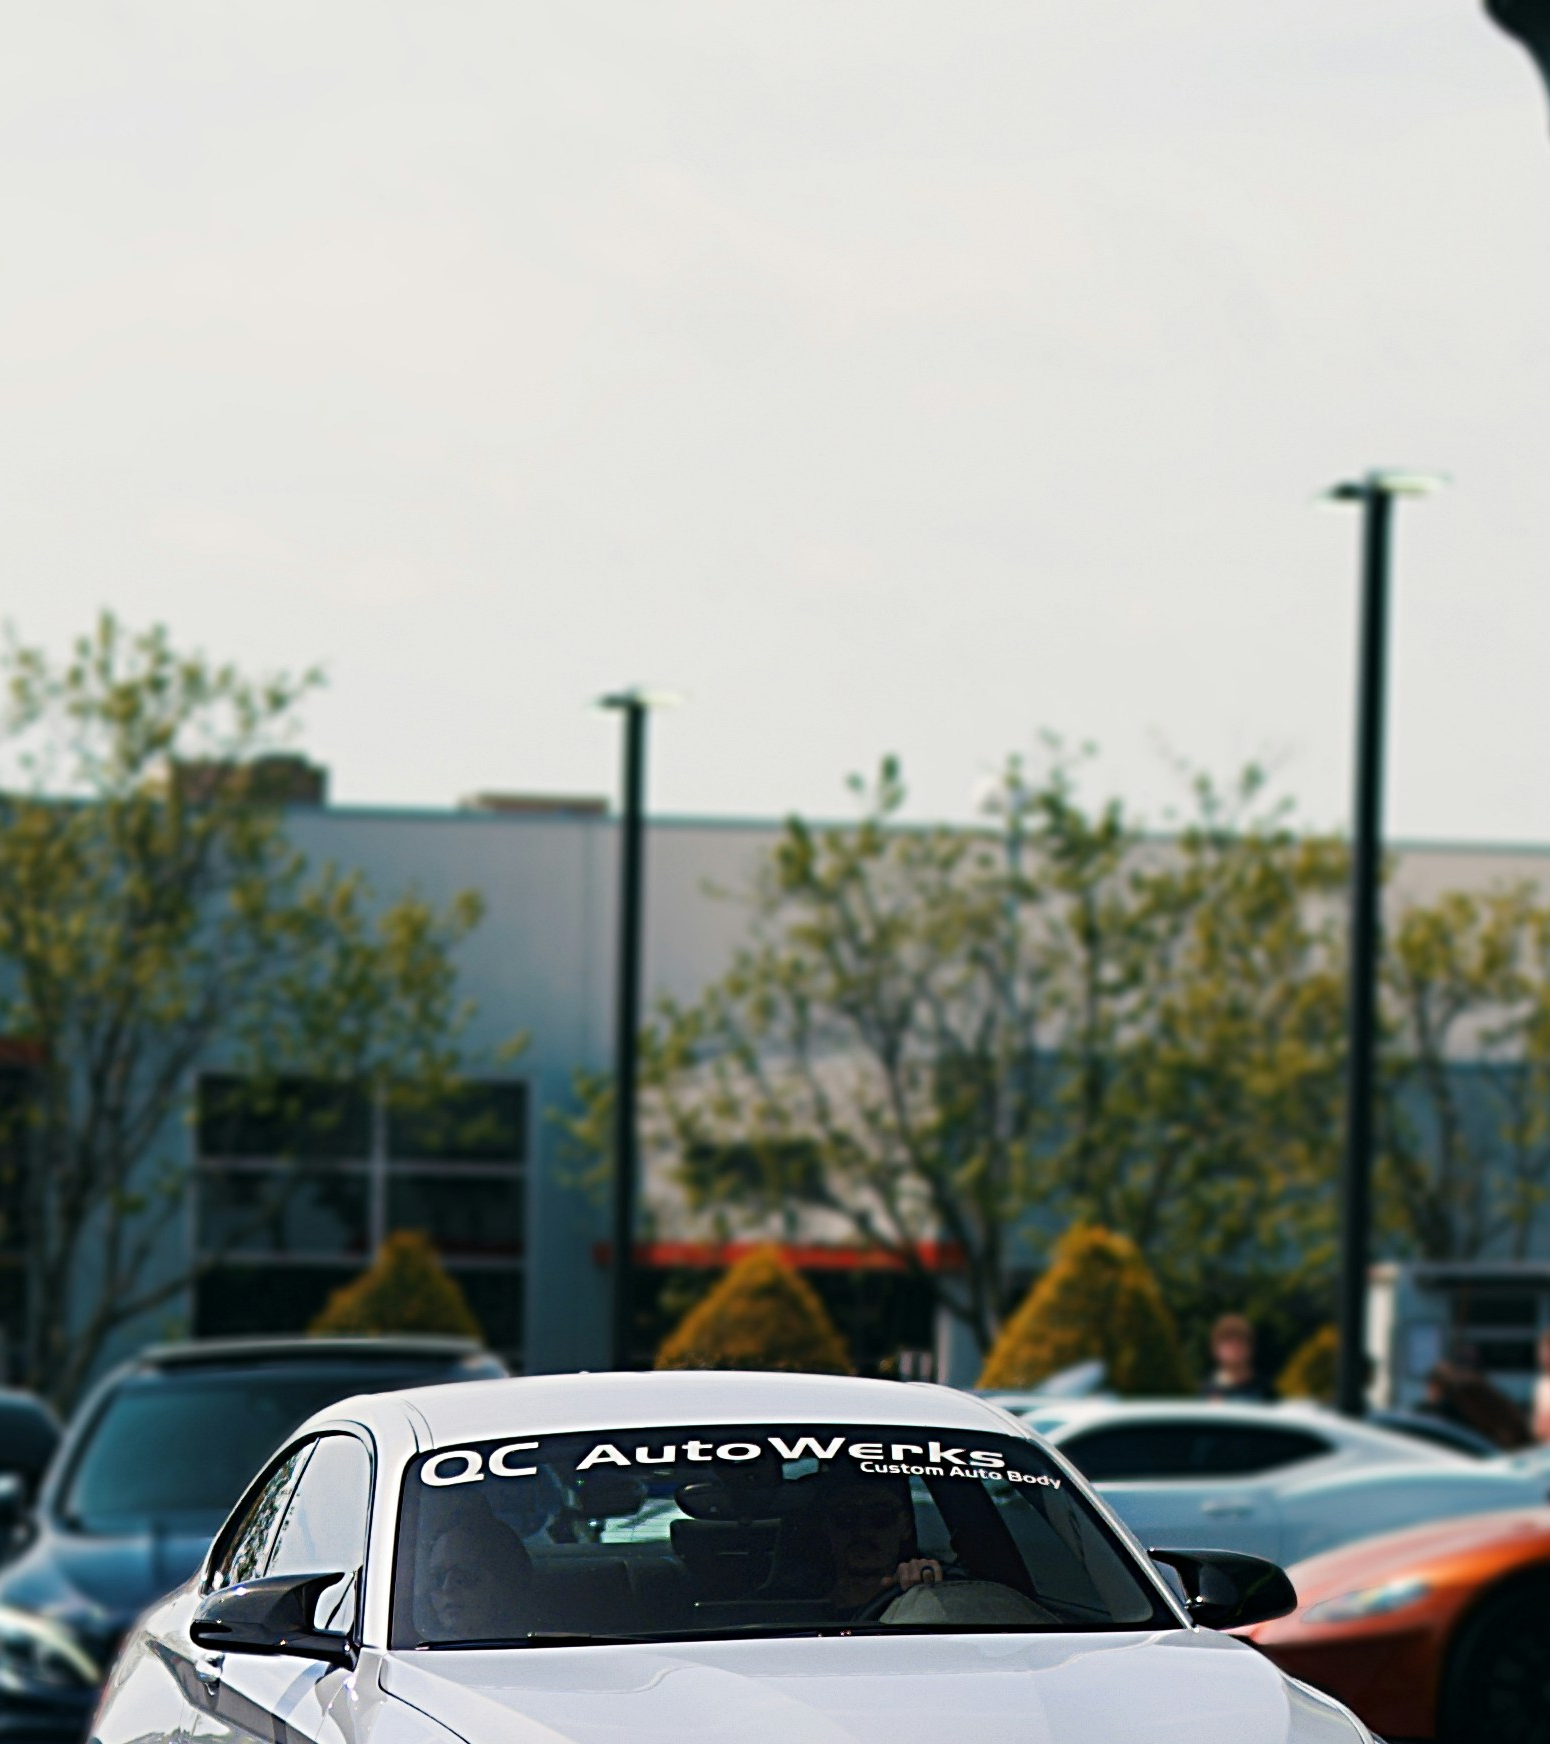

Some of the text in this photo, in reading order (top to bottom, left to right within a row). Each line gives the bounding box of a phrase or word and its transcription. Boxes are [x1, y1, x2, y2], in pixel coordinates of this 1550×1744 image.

[419, 1441, 539, 1487] QC
[859, 1461, 1062, 1490] Custom Auto Body
